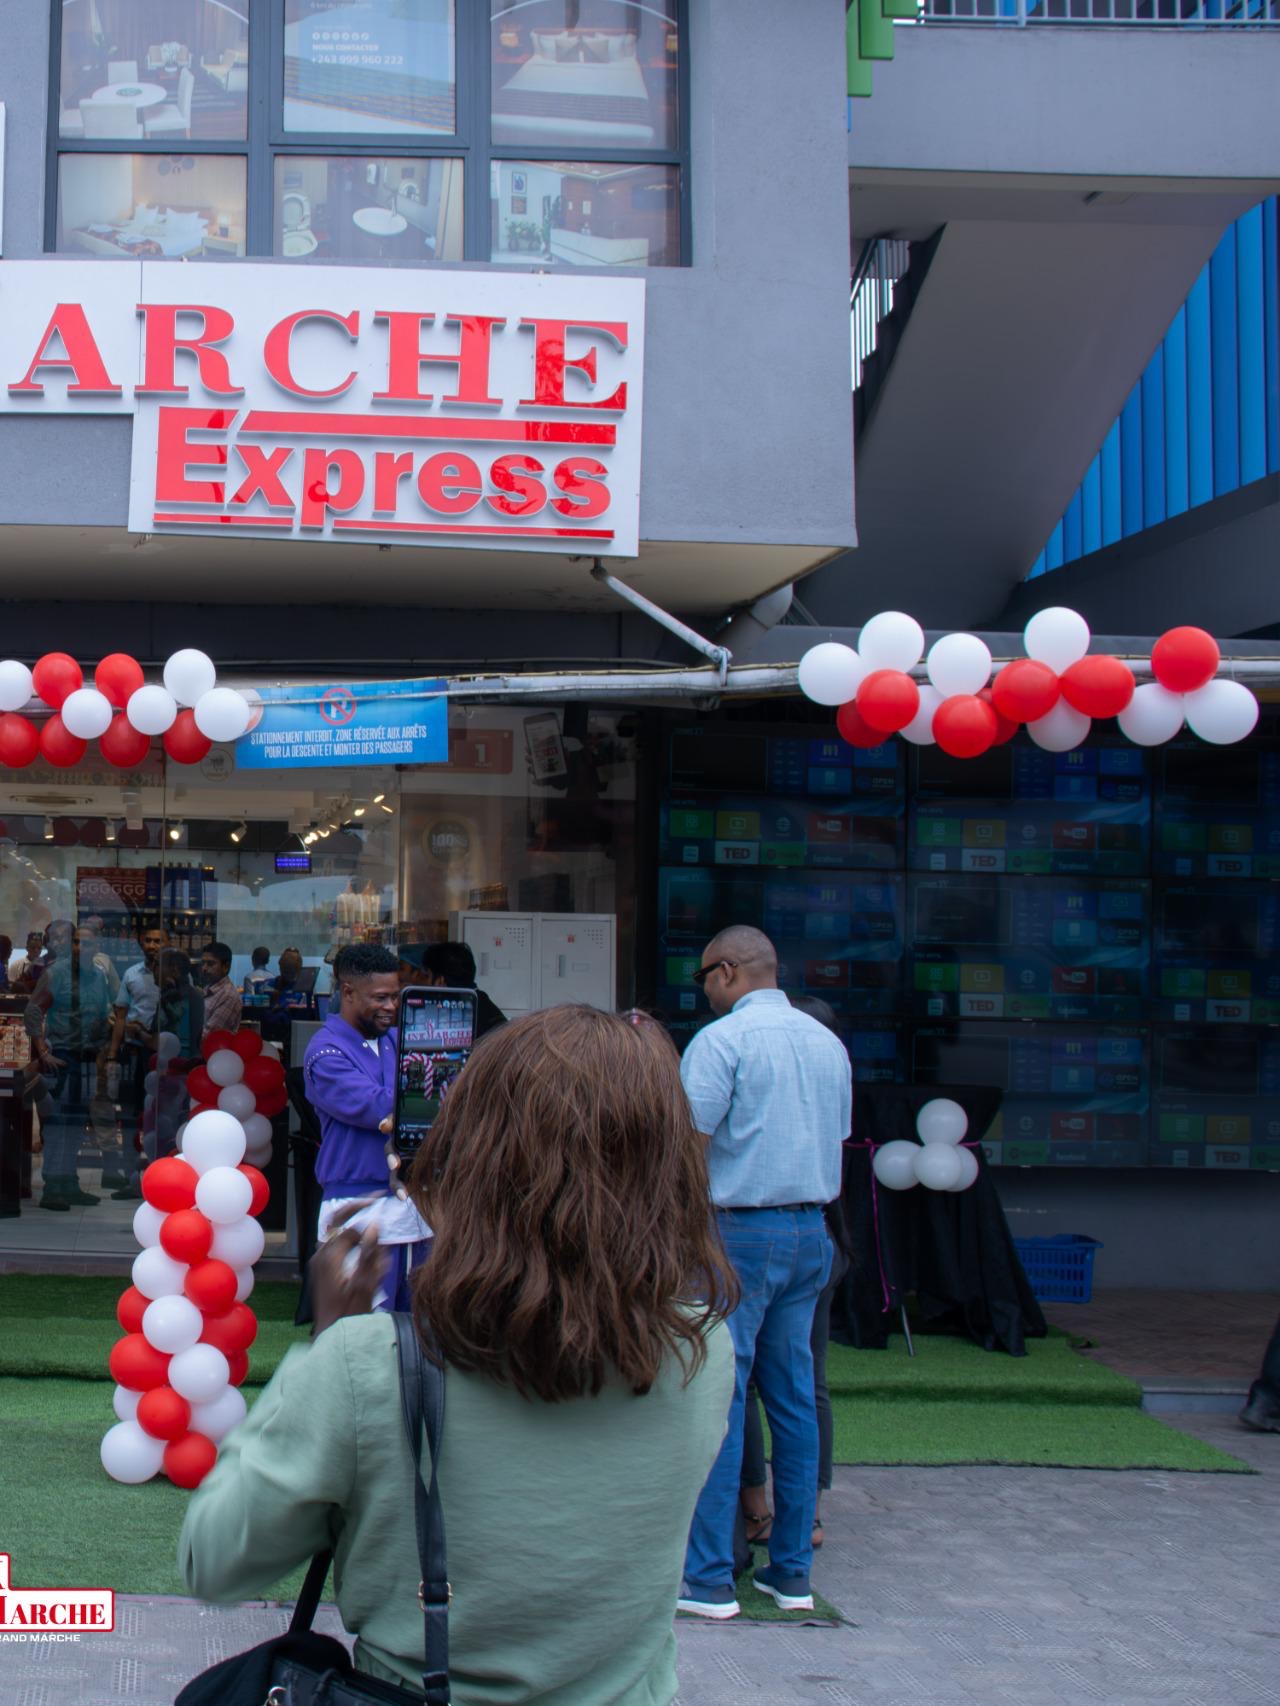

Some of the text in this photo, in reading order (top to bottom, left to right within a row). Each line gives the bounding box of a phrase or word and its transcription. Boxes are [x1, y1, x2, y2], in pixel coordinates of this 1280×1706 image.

[154, 405, 613, 532] Express
[251, 730, 304, 745] STATIONNEMENT
[335, 728, 353, 742] ZONE
[354, 725, 387, 741] RÉSERVÉE
[387, 726, 401, 740] AUX
[402, 723, 427, 739] ARRÊTS
[264, 740, 413, 758] POUR LA DESCENTE ET MONTER DES PASSAGERS
[724, 847, 750, 859] TED
[970, 855, 997, 866] TED
[969, 1001, 995, 1012] TED
[1214, 1006, 1241, 1017] TED
[1214, 1151, 1241, 1163] TED
